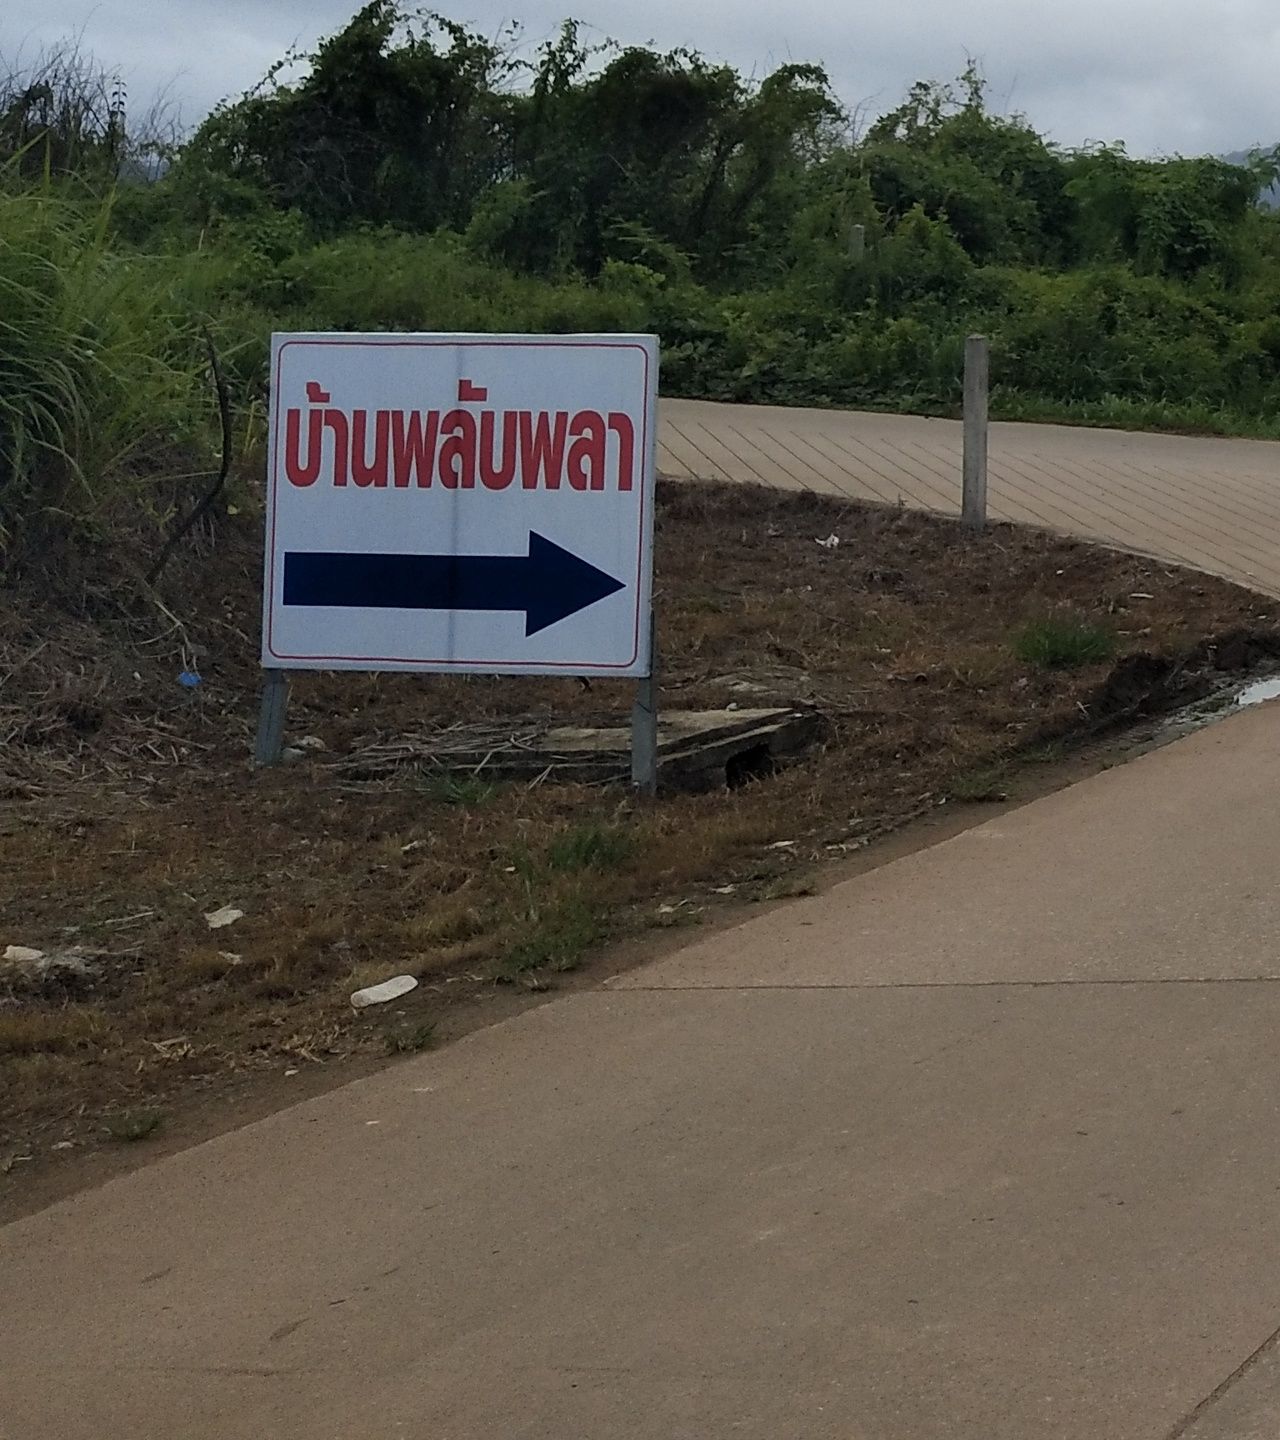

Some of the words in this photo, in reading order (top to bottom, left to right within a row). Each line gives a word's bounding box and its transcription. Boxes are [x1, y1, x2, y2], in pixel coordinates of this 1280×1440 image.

[284, 378, 635, 493] บ้านพลับพลา
